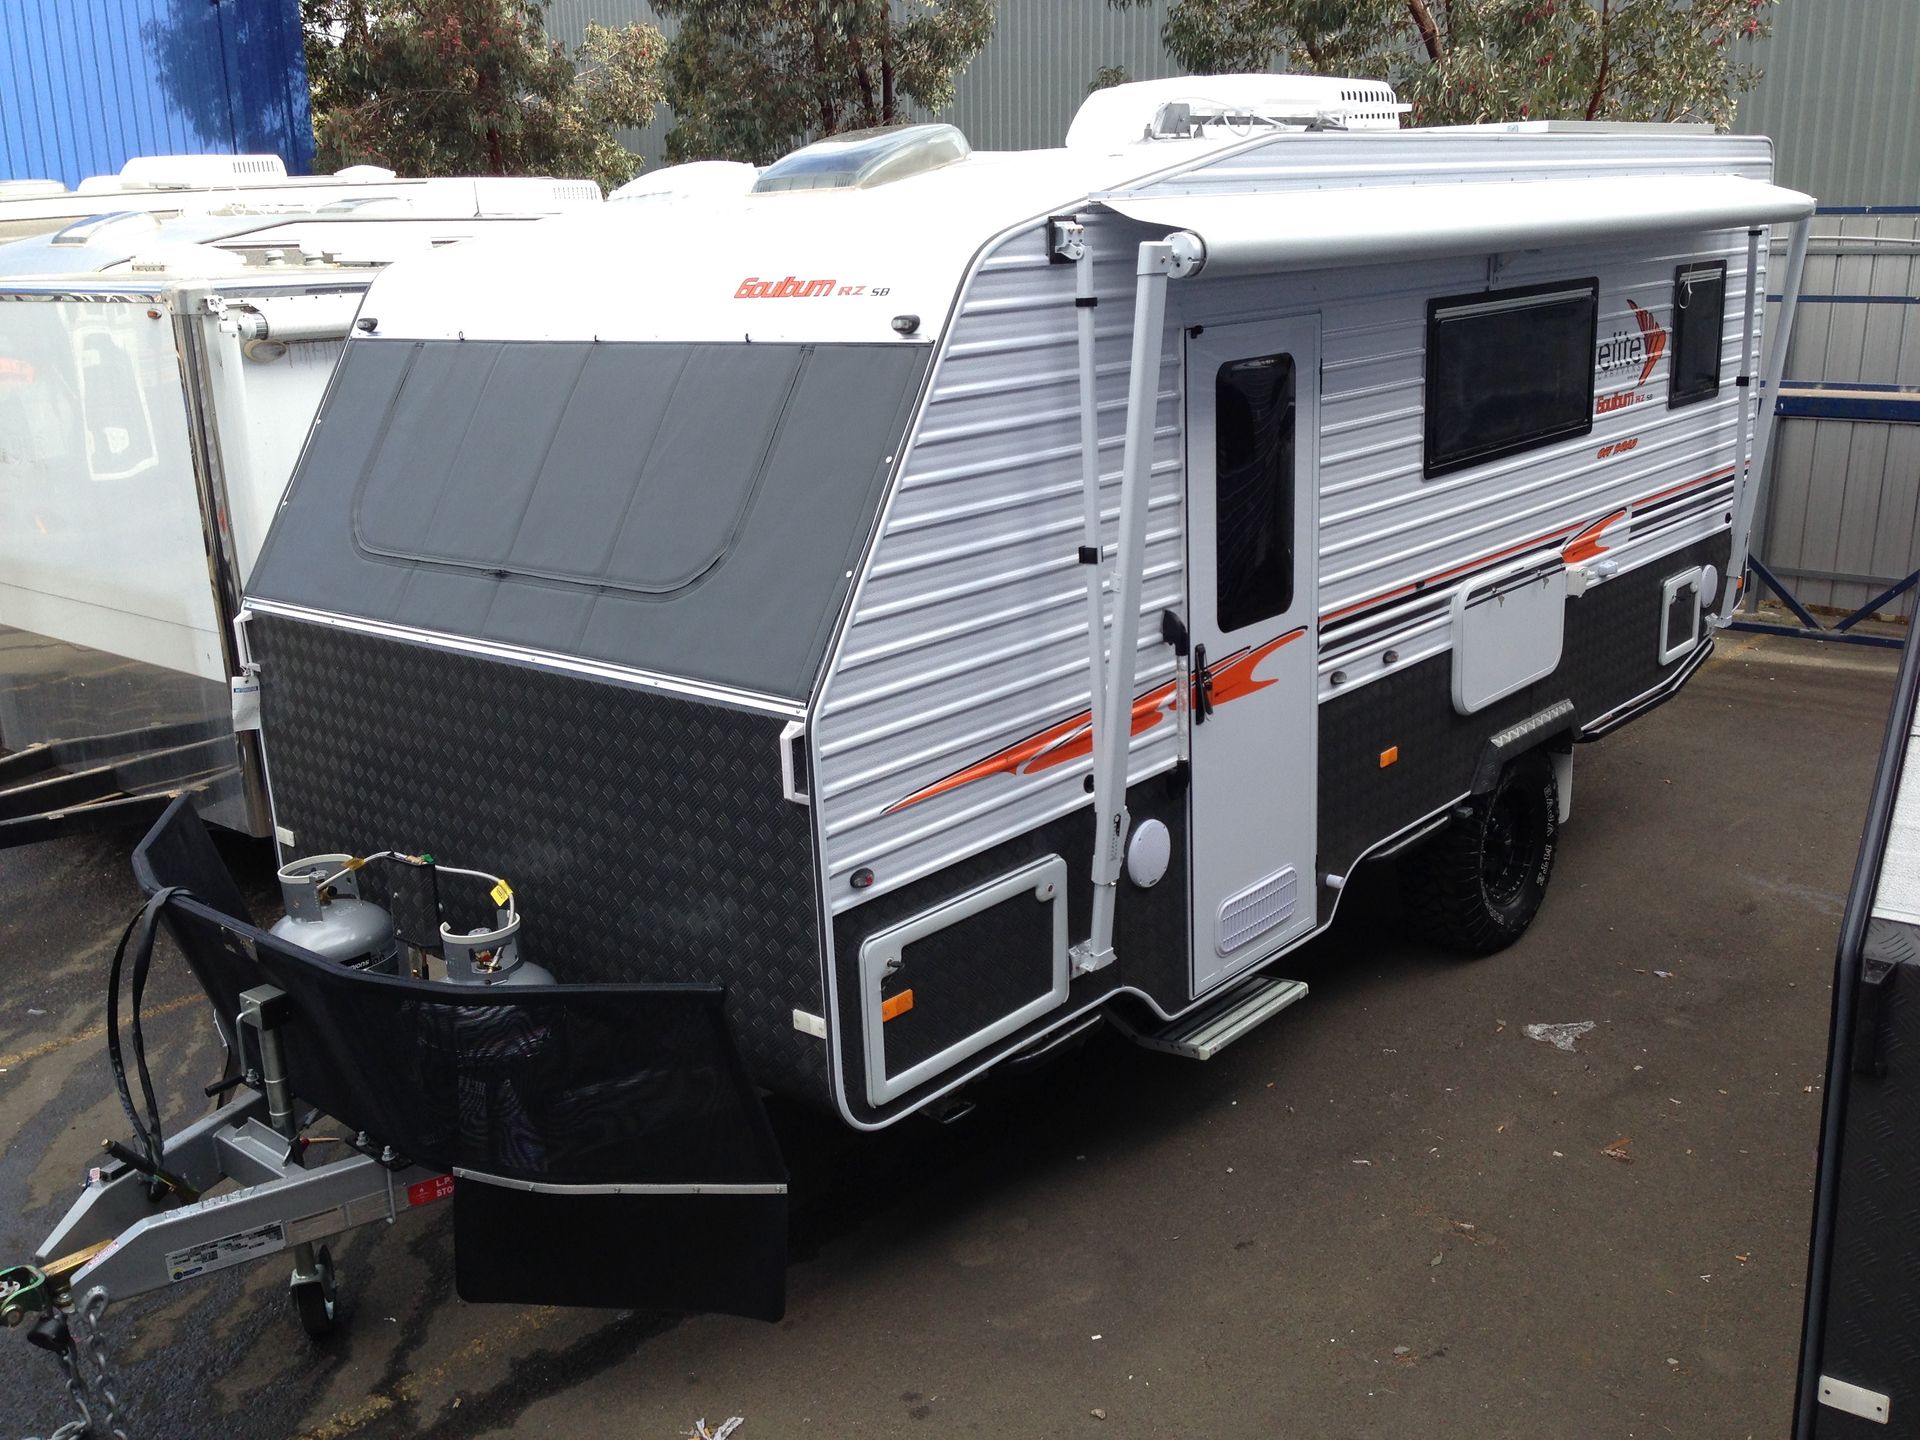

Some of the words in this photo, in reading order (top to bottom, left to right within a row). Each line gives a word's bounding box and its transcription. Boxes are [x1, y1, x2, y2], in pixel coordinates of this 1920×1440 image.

[734, 276, 836, 298] Goulburn
[838, 286, 867, 296] RZ
[1598, 331, 1642, 370] elite
[436, 1185, 454, 1197] STO
